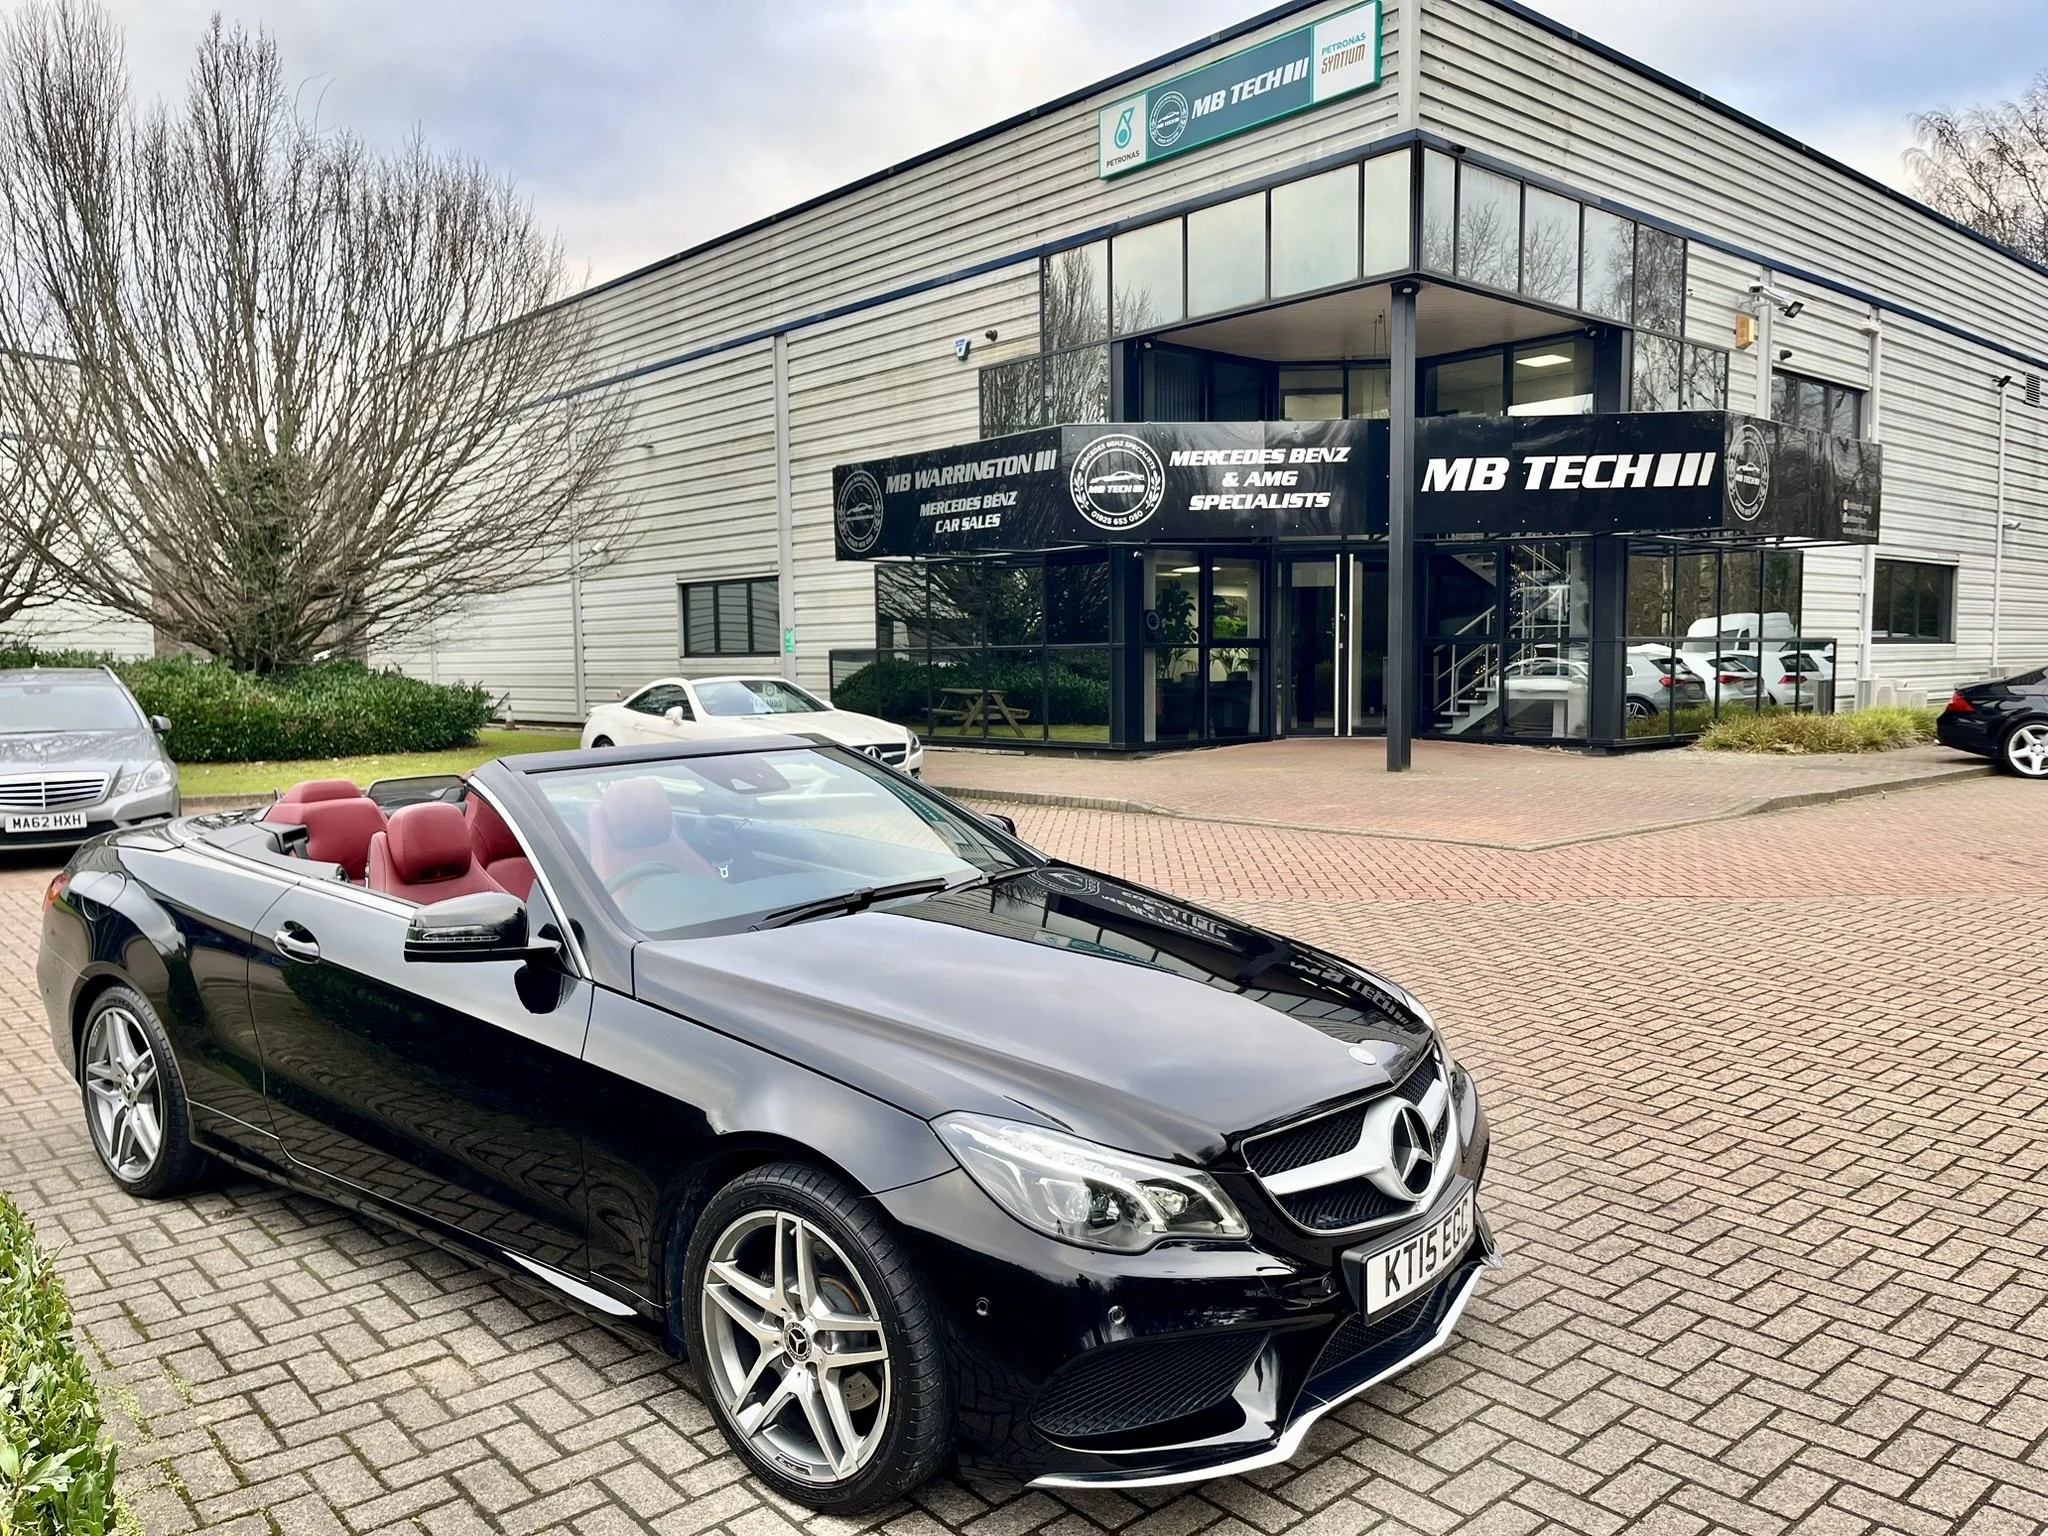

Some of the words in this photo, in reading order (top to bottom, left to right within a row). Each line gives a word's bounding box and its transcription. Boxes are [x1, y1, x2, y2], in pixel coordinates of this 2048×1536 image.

[1321, 32, 1366, 56] PETRONAS
[1321, 44, 1365, 75] SYNTIUM
[1191, 90, 1225, 120] MB
[1106, 150, 1140, 168] PETRONAS
[1079, 443, 1106, 470] MERCEDES
[1106, 440, 1124, 448] BENZ
[1125, 441, 1157, 470] SPECIALISTS
[1169, 448, 1287, 467] MERCEDES
[1288, 446, 1351, 463] BENZ
[885, 472, 913, 495] MB
[914, 453, 1033, 490] WARRINGTON
[1222, 471, 1240, 487] &
[1242, 470, 1299, 487] AMG
[1420, 457, 1509, 493] MB
[920, 495, 982, 517] MERCEDES
[983, 491, 1019, 509] BENZ
[1188, 492, 1331, 511] SPECIALISTS
[935, 517, 960, 534] CAR
[961, 513, 1001, 531] SALES
[1091, 510, 1112, 525] 01925
[1113, 517, 1128, 525] 653
[1128, 510, 1144, 522] 050
[12, 814, 50, 829] MA62
[54, 813, 81, 827] HXH
[1385, 1227, 1438, 1298] KT15
